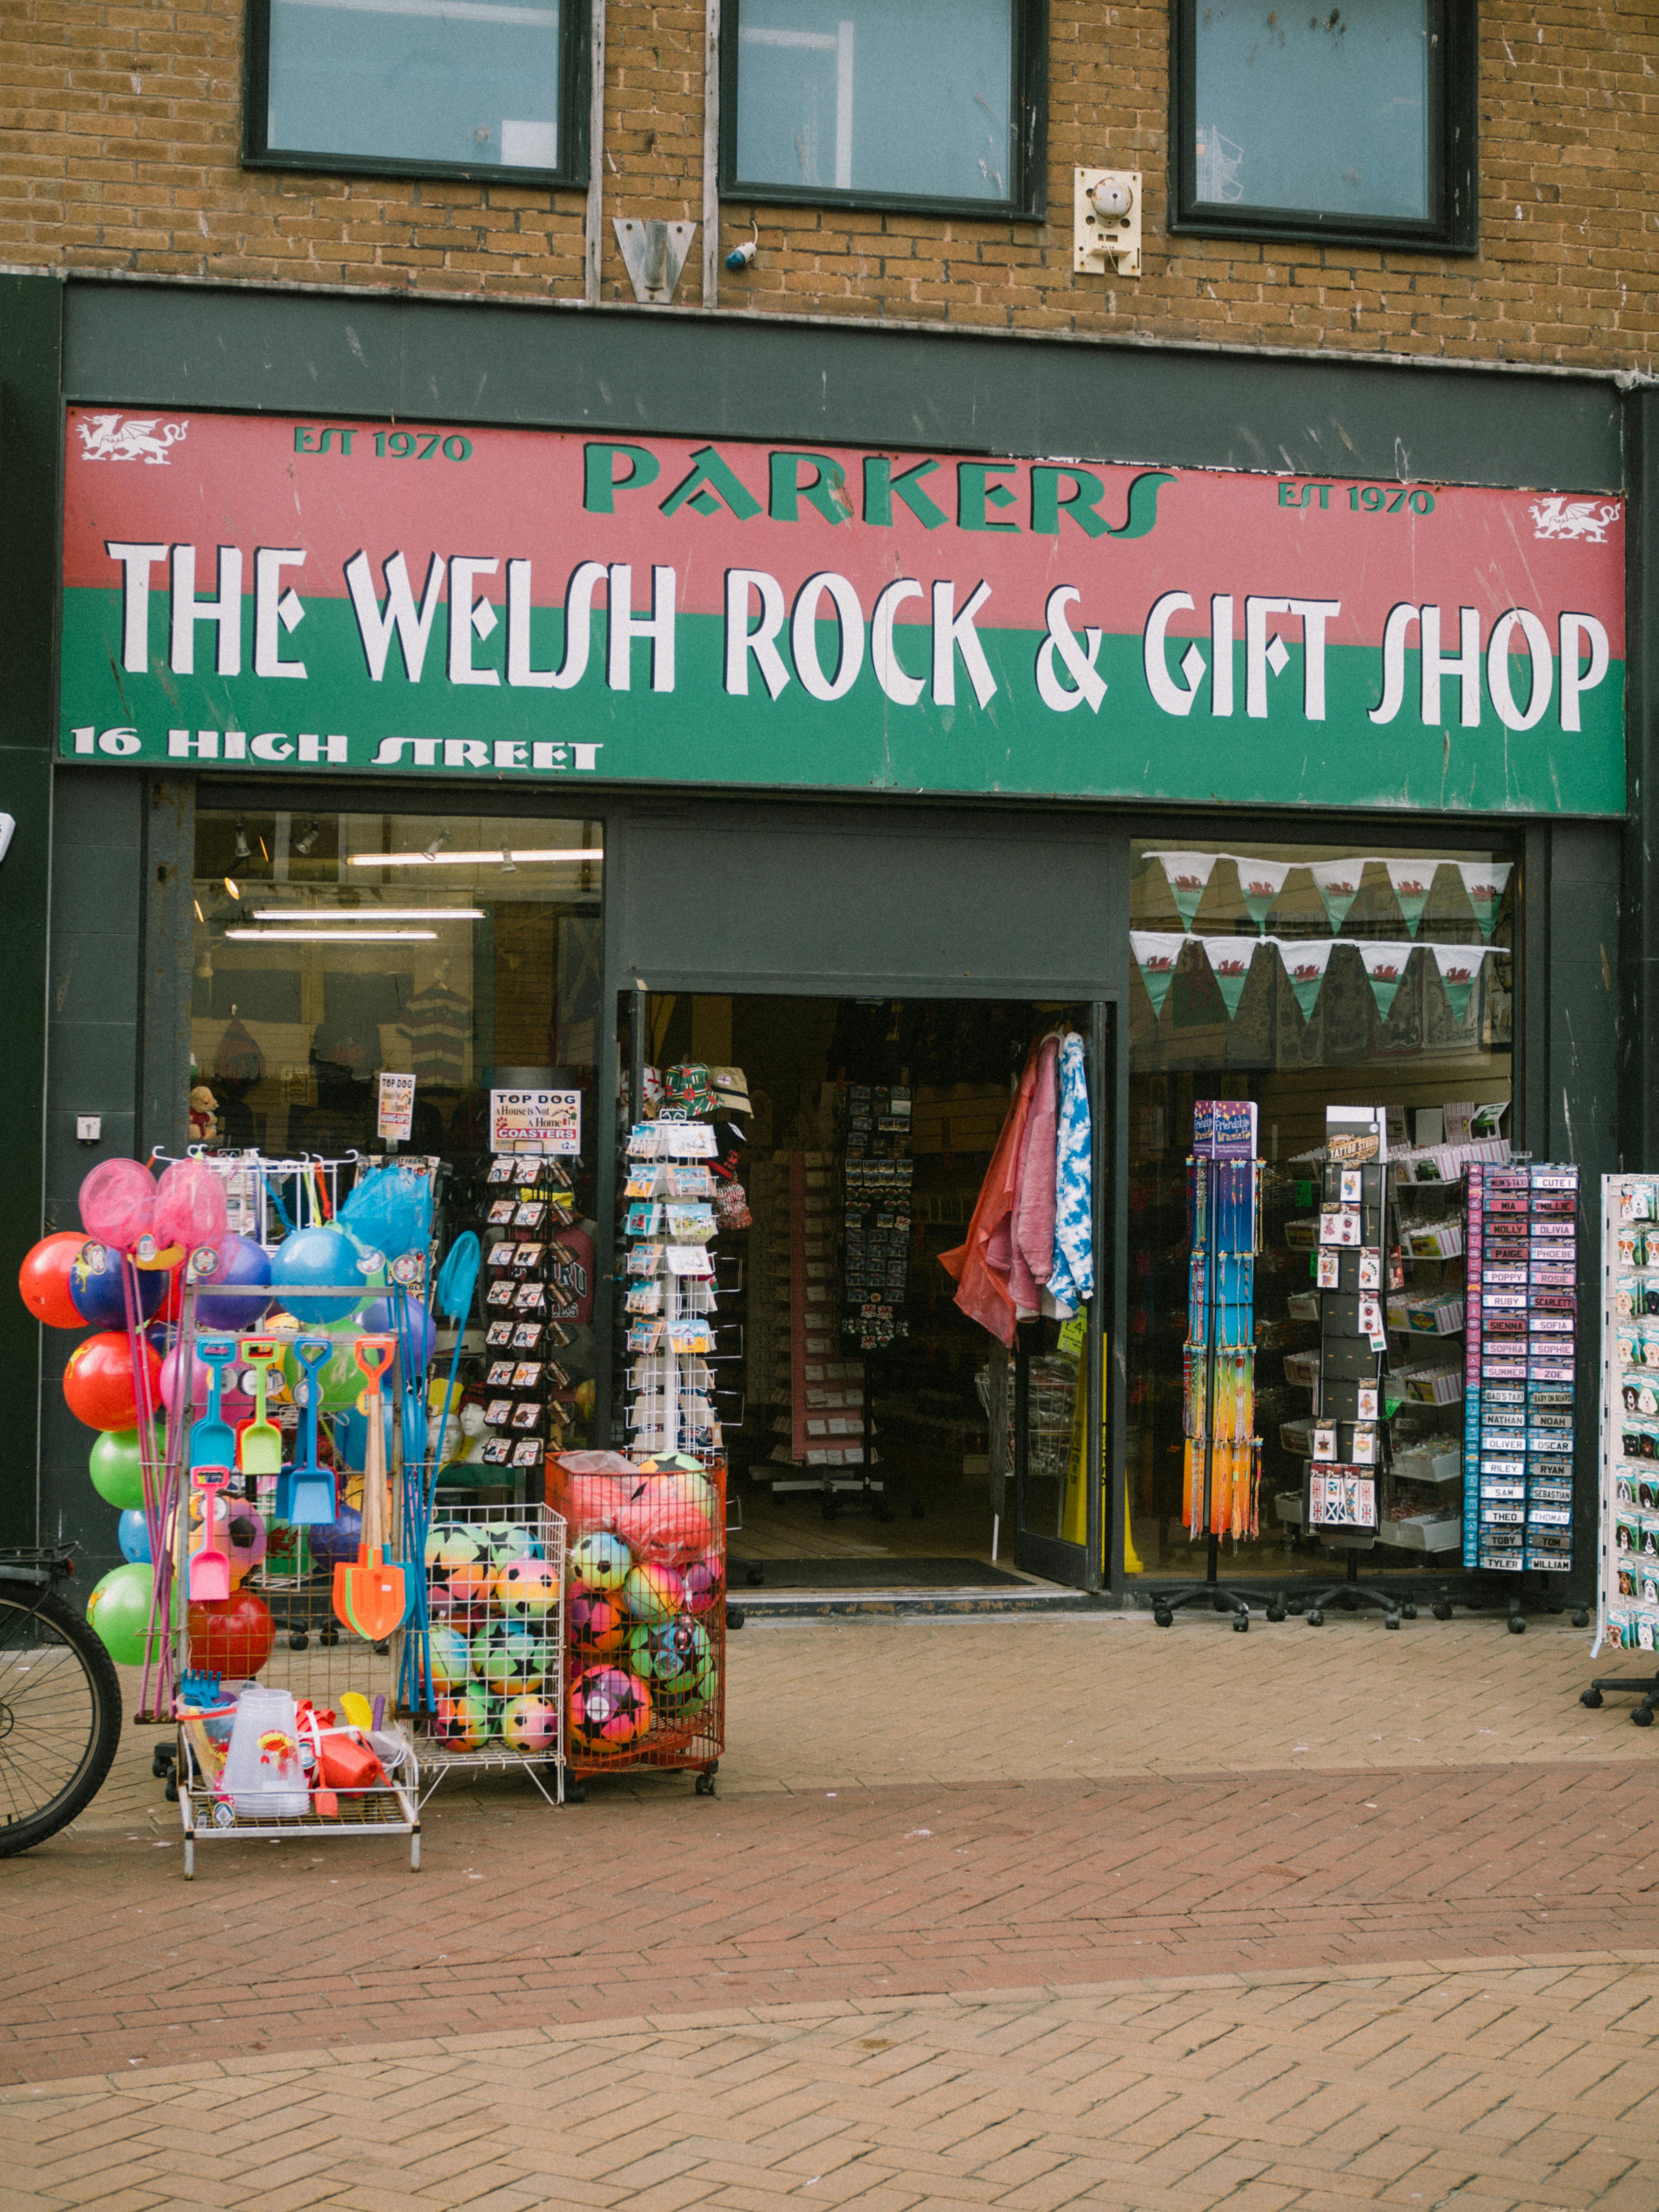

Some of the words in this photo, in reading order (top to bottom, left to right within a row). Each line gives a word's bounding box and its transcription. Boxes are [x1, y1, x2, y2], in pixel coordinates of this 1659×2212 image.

[294, 426, 359, 456] EST
[373, 431, 474, 463] 1970
[582, 441, 1179, 540] PARKERS
[1278, 481, 1335, 511] EST
[1347, 485, 1436, 515] 1970
[104, 540, 309, 680] THE
[343, 547, 677, 694] WELSH
[723, 566, 998, 712] ROCK
[1034, 583, 1109, 715] &
[1142, 590, 1342, 721] GIFT
[1367, 601, 1610, 733] SHOP
[70, 725, 142, 756] 16
[167, 729, 349, 764] HIGH
[370, 735, 604, 771] STREET
[382, 1078, 395, 1088] TOP
[397, 1079, 412, 1088] DOG
[496, 1094, 532, 1103] TOP
[538, 1095, 576, 1104] DOG
[381, 1113, 410, 1123] HANG-UPS
[498, 1129, 574, 1138] COASTERS
[1330, 1143, 1356, 1159] TATTOO
[1358, 1136, 1379, 1151] STUDIO
[1491, 1178, 1511, 1187] MUM'S
[1512, 1178, 1527, 1187] TAXI
[1540, 1202, 1571, 1211] MILLIE
[1540, 1226, 1569, 1234] OLIVIA
[1496, 1250, 1523, 1258] PAIGE
[1541, 1275, 1568, 1283] ROSIE
[1494, 1298, 1519, 1306] RUBY
[1534, 1298, 1572, 1307] SCARLETT
[1490, 1322, 1523, 1330] SIENNA
[1490, 1345, 1523, 1353] SOPHIA
[1488, 1368, 1525, 1377] SUMMER
[1544, 1371, 1563, 1379] ZOE
[1487, 1392, 1506, 1400] DAD'S
[1508, 1393, 1523, 1401] TAXI
[1534, 1394, 1547, 1403] BABY
[1548, 1394, 1554, 1403] ON
[1555, 1394, 1572, 1403] BOARD
[1487, 1415, 1522, 1424] NATHAN
[1540, 1417, 1566, 1426] NOAH
[1489, 1440, 1522, 1448] OLIVER
[1538, 1441, 1569, 1450] OSCAR
[1491, 1464, 1517, 1473] RILEY
[1540, 1465, 1564, 1474] RYAN
[1534, 1490, 1570, 1499] SEBASTIAN
[1493, 1513, 1517, 1521] THEO
[1534, 1513, 1568, 1522] THOMAS
[1491, 1537, 1515, 1545] TOBY
[1542, 1538, 1561, 1546] TOM
[1488, 1559, 1518, 1568] TYLER
[1533, 1560, 1569, 1569] WILLIAM
